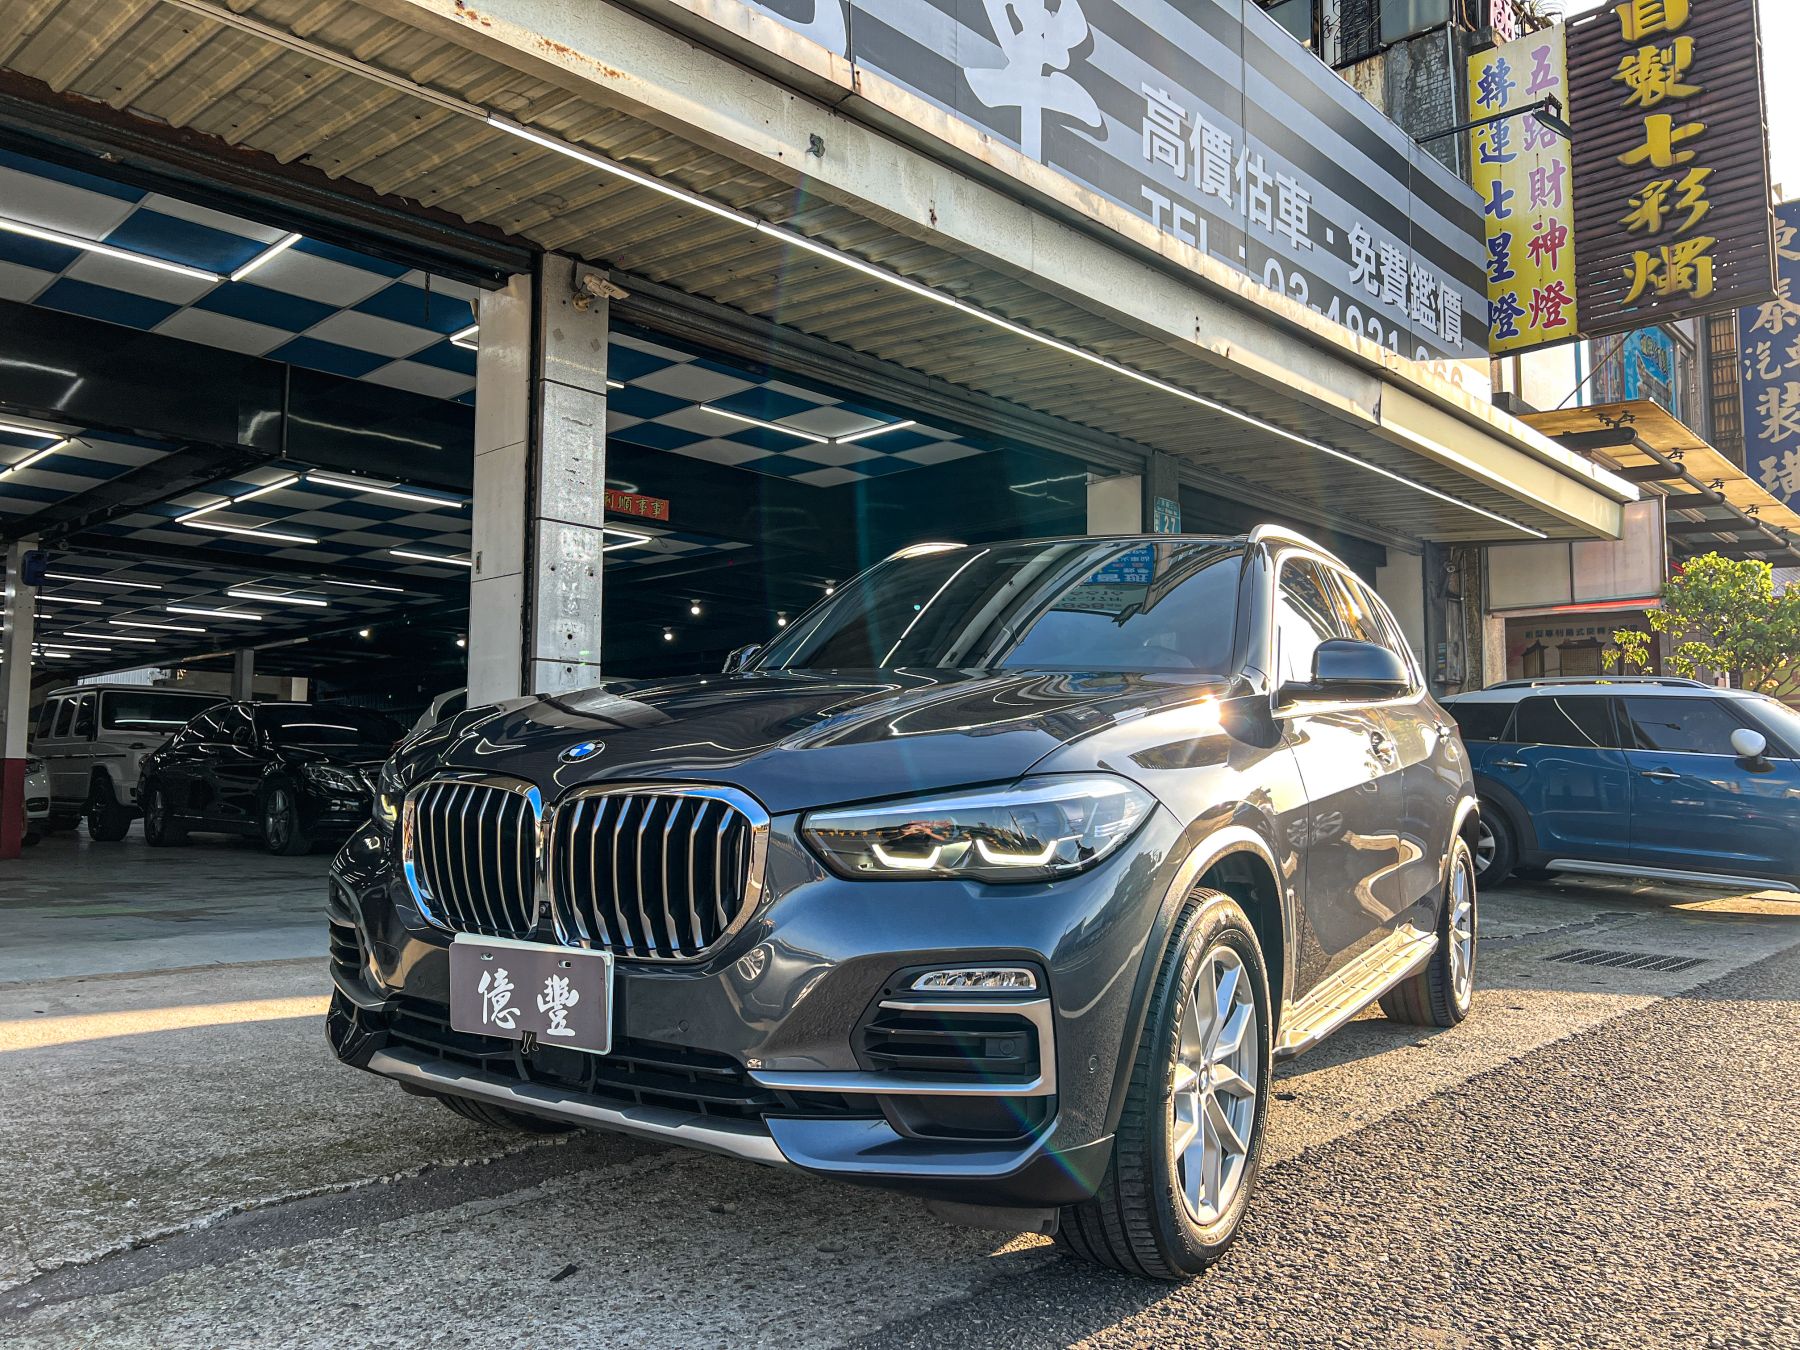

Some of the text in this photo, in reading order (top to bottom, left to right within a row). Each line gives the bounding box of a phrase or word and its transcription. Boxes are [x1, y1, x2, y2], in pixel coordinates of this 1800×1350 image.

[1476, 57, 1526, 340] 轉運七星燈
[1523, 44, 1574, 330] 五路財神燈
[1611, 0, 1717, 304] 自製七彩燭
[477, 967, 580, 1037] 億豐
